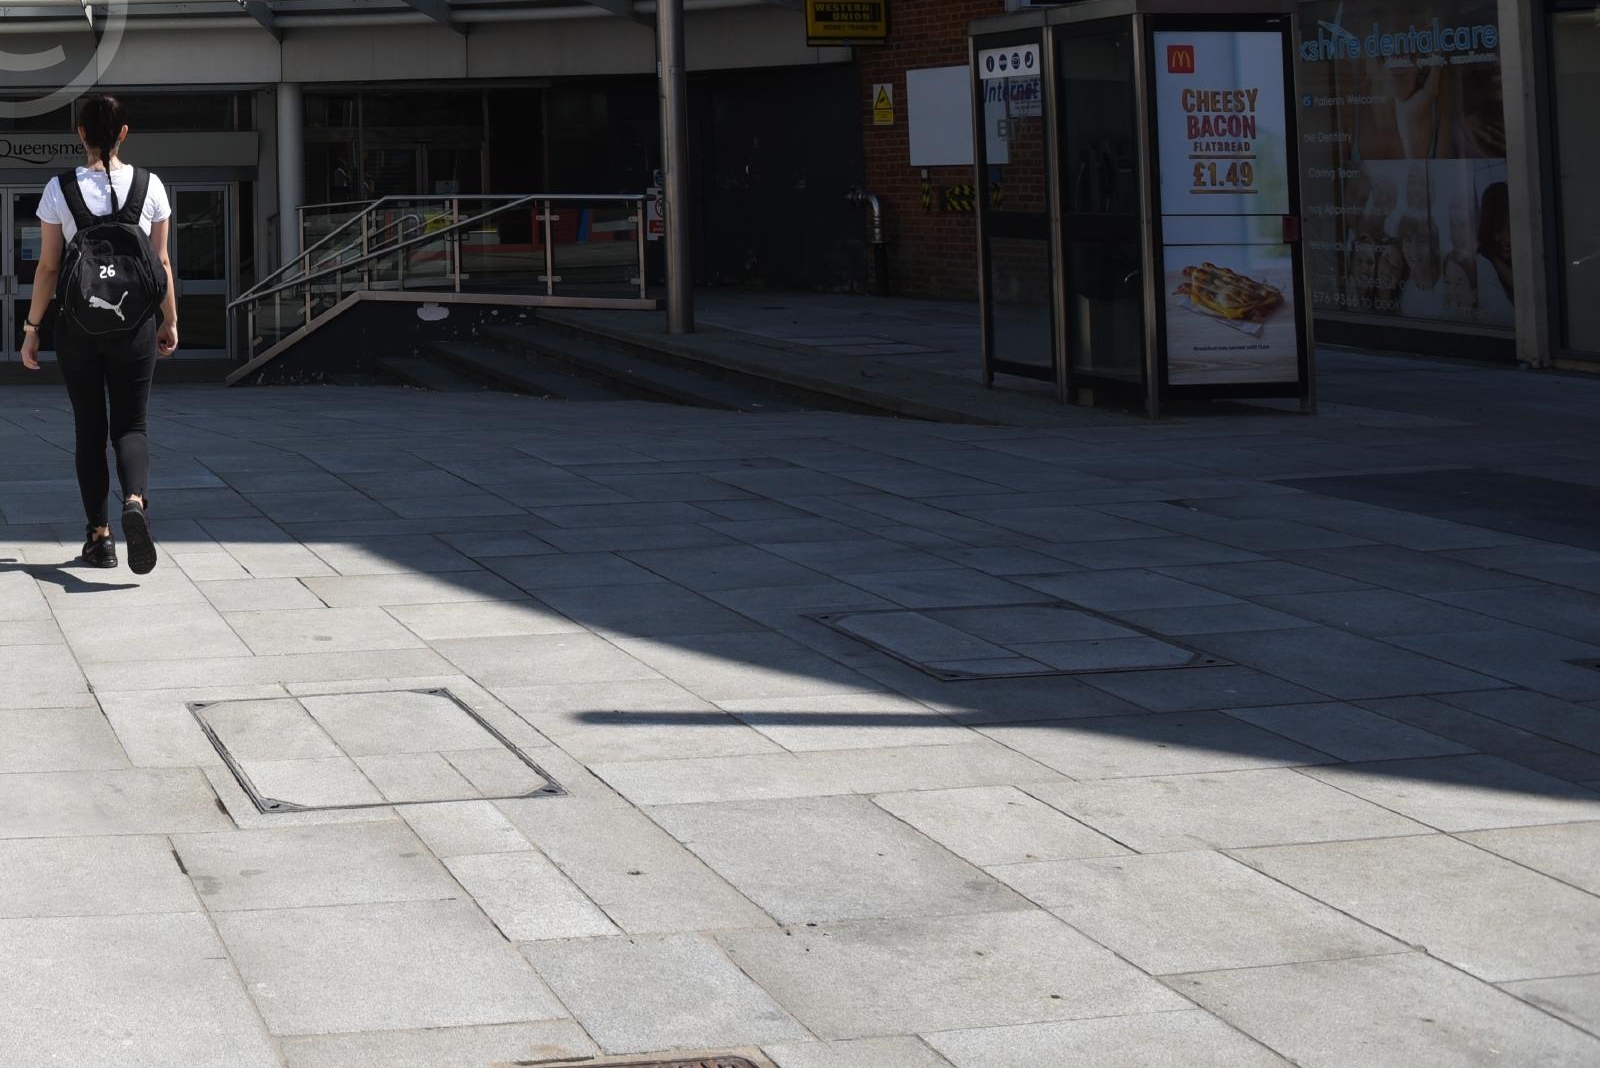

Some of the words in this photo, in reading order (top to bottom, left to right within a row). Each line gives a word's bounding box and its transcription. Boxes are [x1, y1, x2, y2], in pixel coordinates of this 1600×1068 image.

[815, 3, 870, 12] WESTERN
[832, 12, 870, 21] UNION
[1366, 17, 1498, 58] dentalcare
[983, 80, 1041, 104] Internet
[1181, 87, 1258, 113] CHEESY
[1187, 114, 1257, 140] BACON
[1193, 141, 1251, 152] FLATBREAD
[1193, 161, 1253, 187] £1.49
[100, 264, 116, 279] 26
